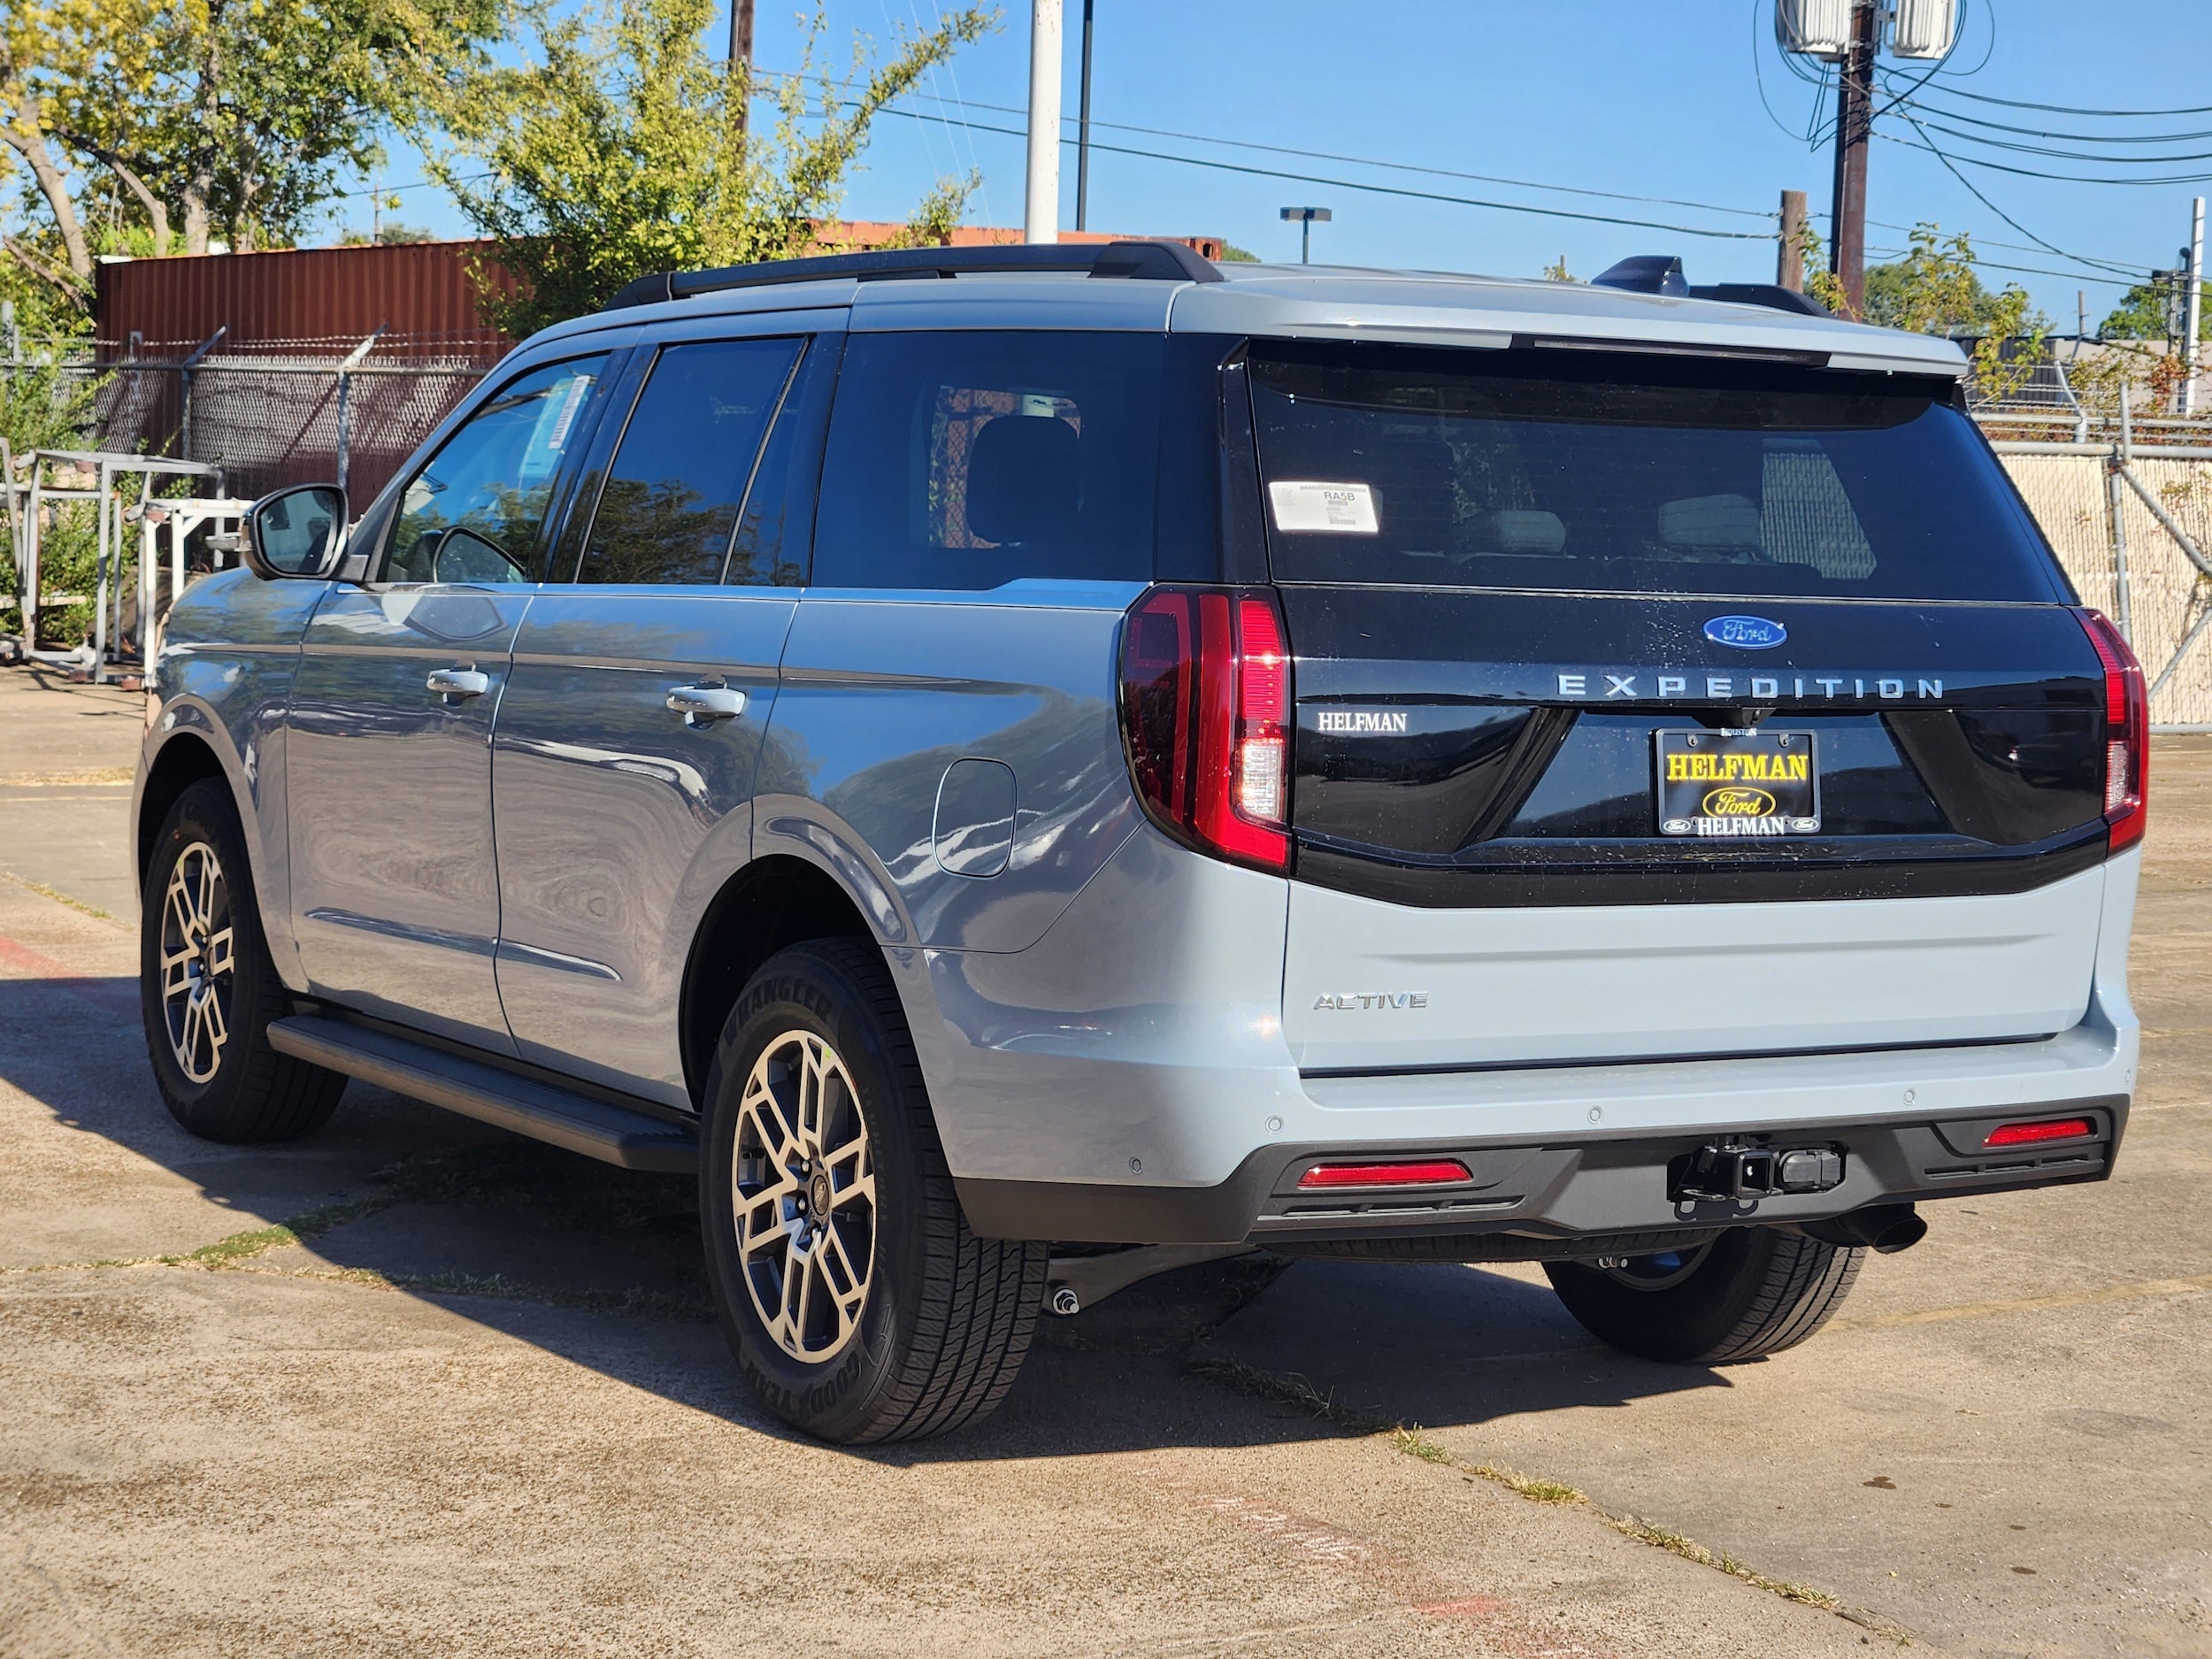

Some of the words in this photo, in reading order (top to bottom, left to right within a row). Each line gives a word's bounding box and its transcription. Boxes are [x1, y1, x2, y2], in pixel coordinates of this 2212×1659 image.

[1324, 491, 1356, 502] RA5B
[1722, 619, 1772, 641] Ford
[1557, 674, 1944, 699] EXPEDITION
[1317, 712, 1408, 732] HELFMAN
[1720, 727, 1757, 736] HOUSTON
[1666, 754, 1809, 781] HELFMAN
[1714, 791, 1763, 815] Ford
[1697, 817, 1786, 835] HELFMAN
[1313, 991, 1428, 1010] ACTIVE
[723, 975, 834, 1048] WRANGLER
